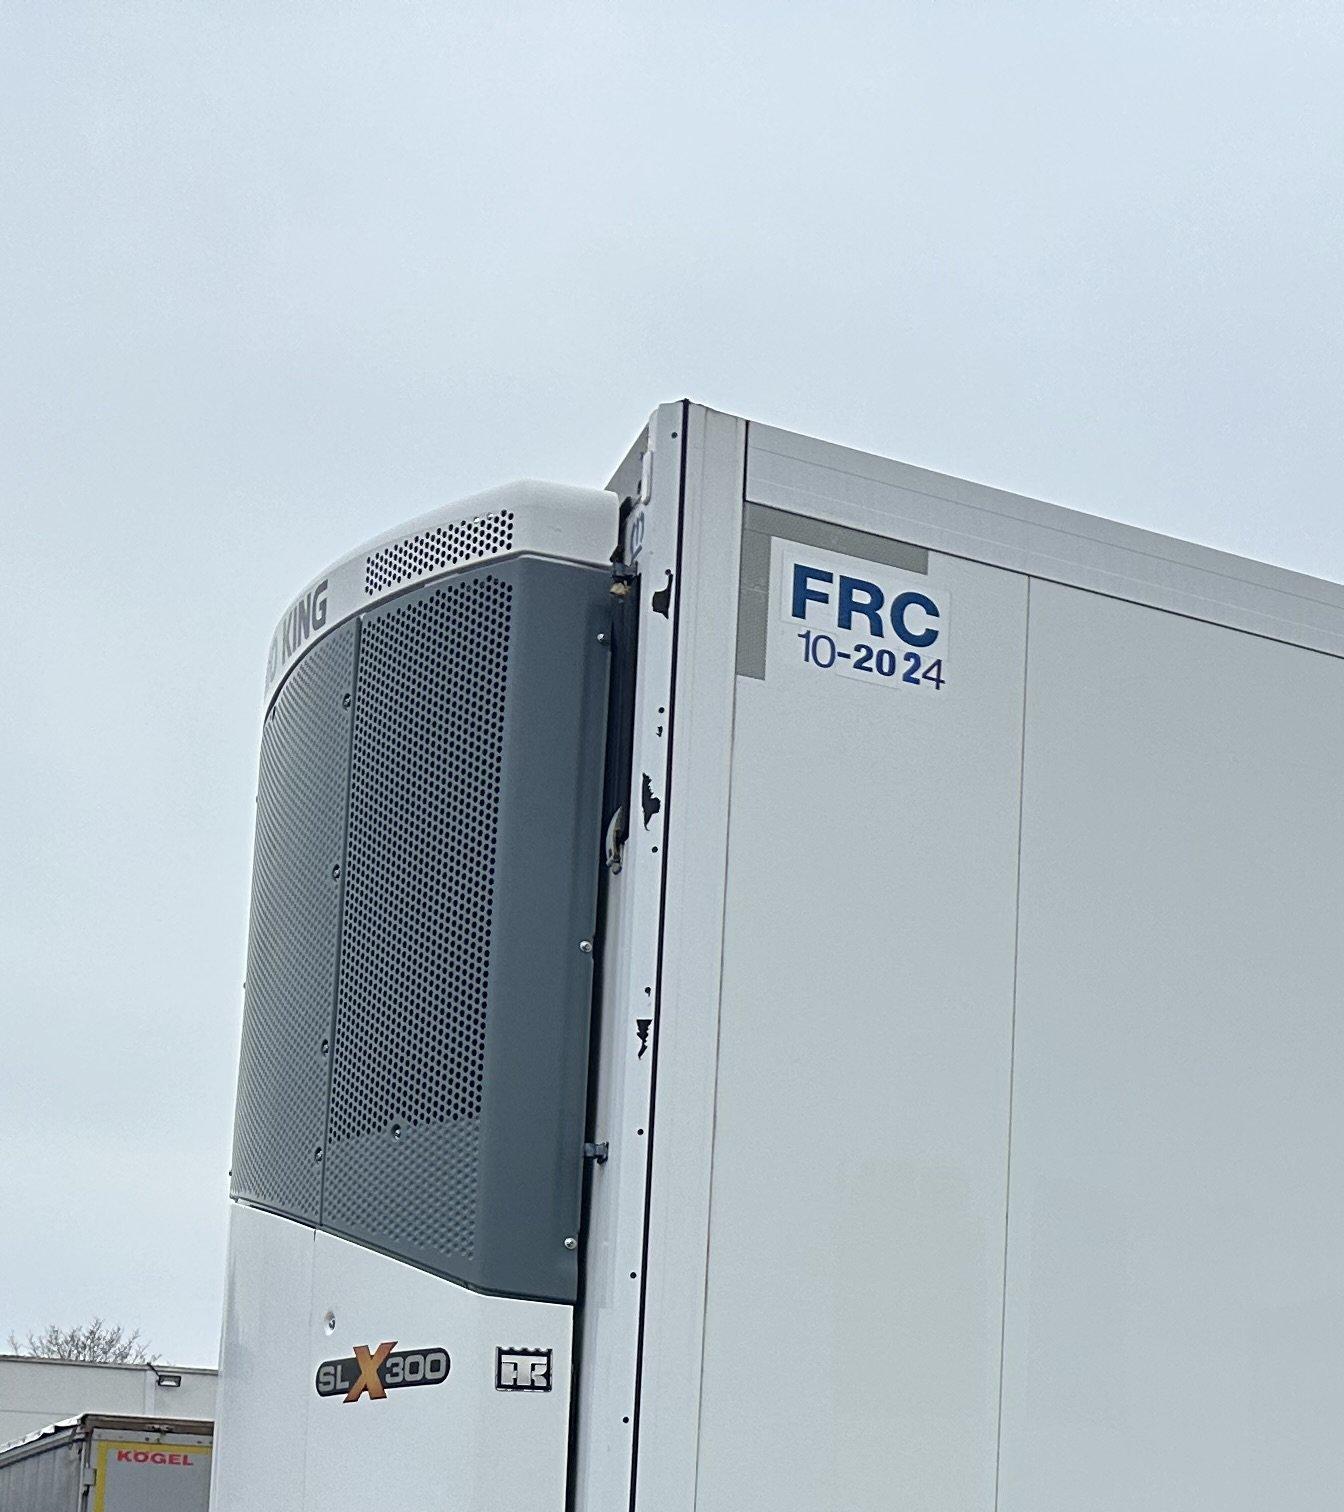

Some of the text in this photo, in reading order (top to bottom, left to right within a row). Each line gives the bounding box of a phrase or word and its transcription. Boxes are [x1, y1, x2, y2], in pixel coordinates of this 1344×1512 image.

[281, 579, 328, 665] KING
[792, 563, 940, 647] FRC
[797, 630, 945, 690] 10-2024
